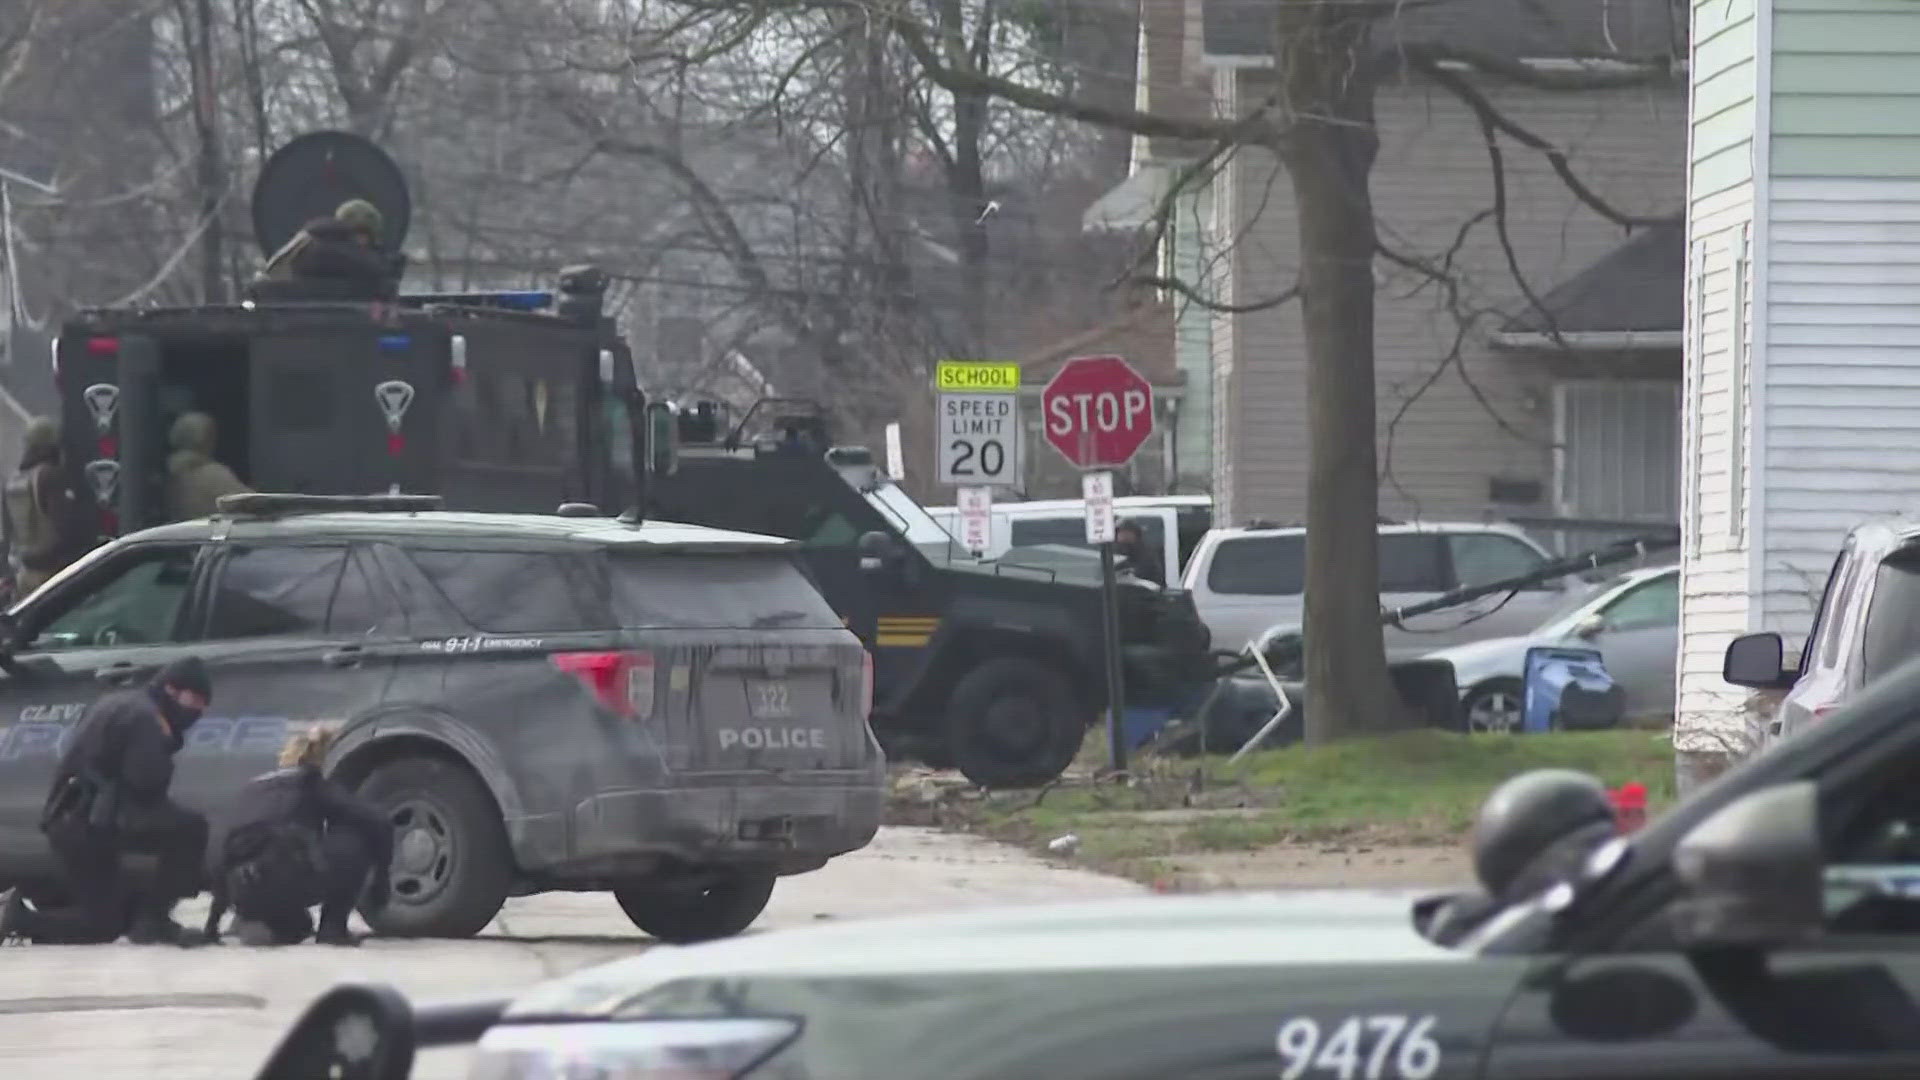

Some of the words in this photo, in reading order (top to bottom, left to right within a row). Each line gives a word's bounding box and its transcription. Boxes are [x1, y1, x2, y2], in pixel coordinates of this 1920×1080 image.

[943, 367, 1011, 385] SCHOOL
[947, 400, 1009, 417] SPEED
[1050, 390, 1146, 436] STOP
[952, 419, 1003, 435] LIMIT
[950, 440, 1004, 476] 20
[445, 637, 481, 652] 9-1-1
[19, 704, 85, 721] CLEV
[719, 727, 825, 751] POLICE
[1276, 1014, 1441, 1080] 9476
